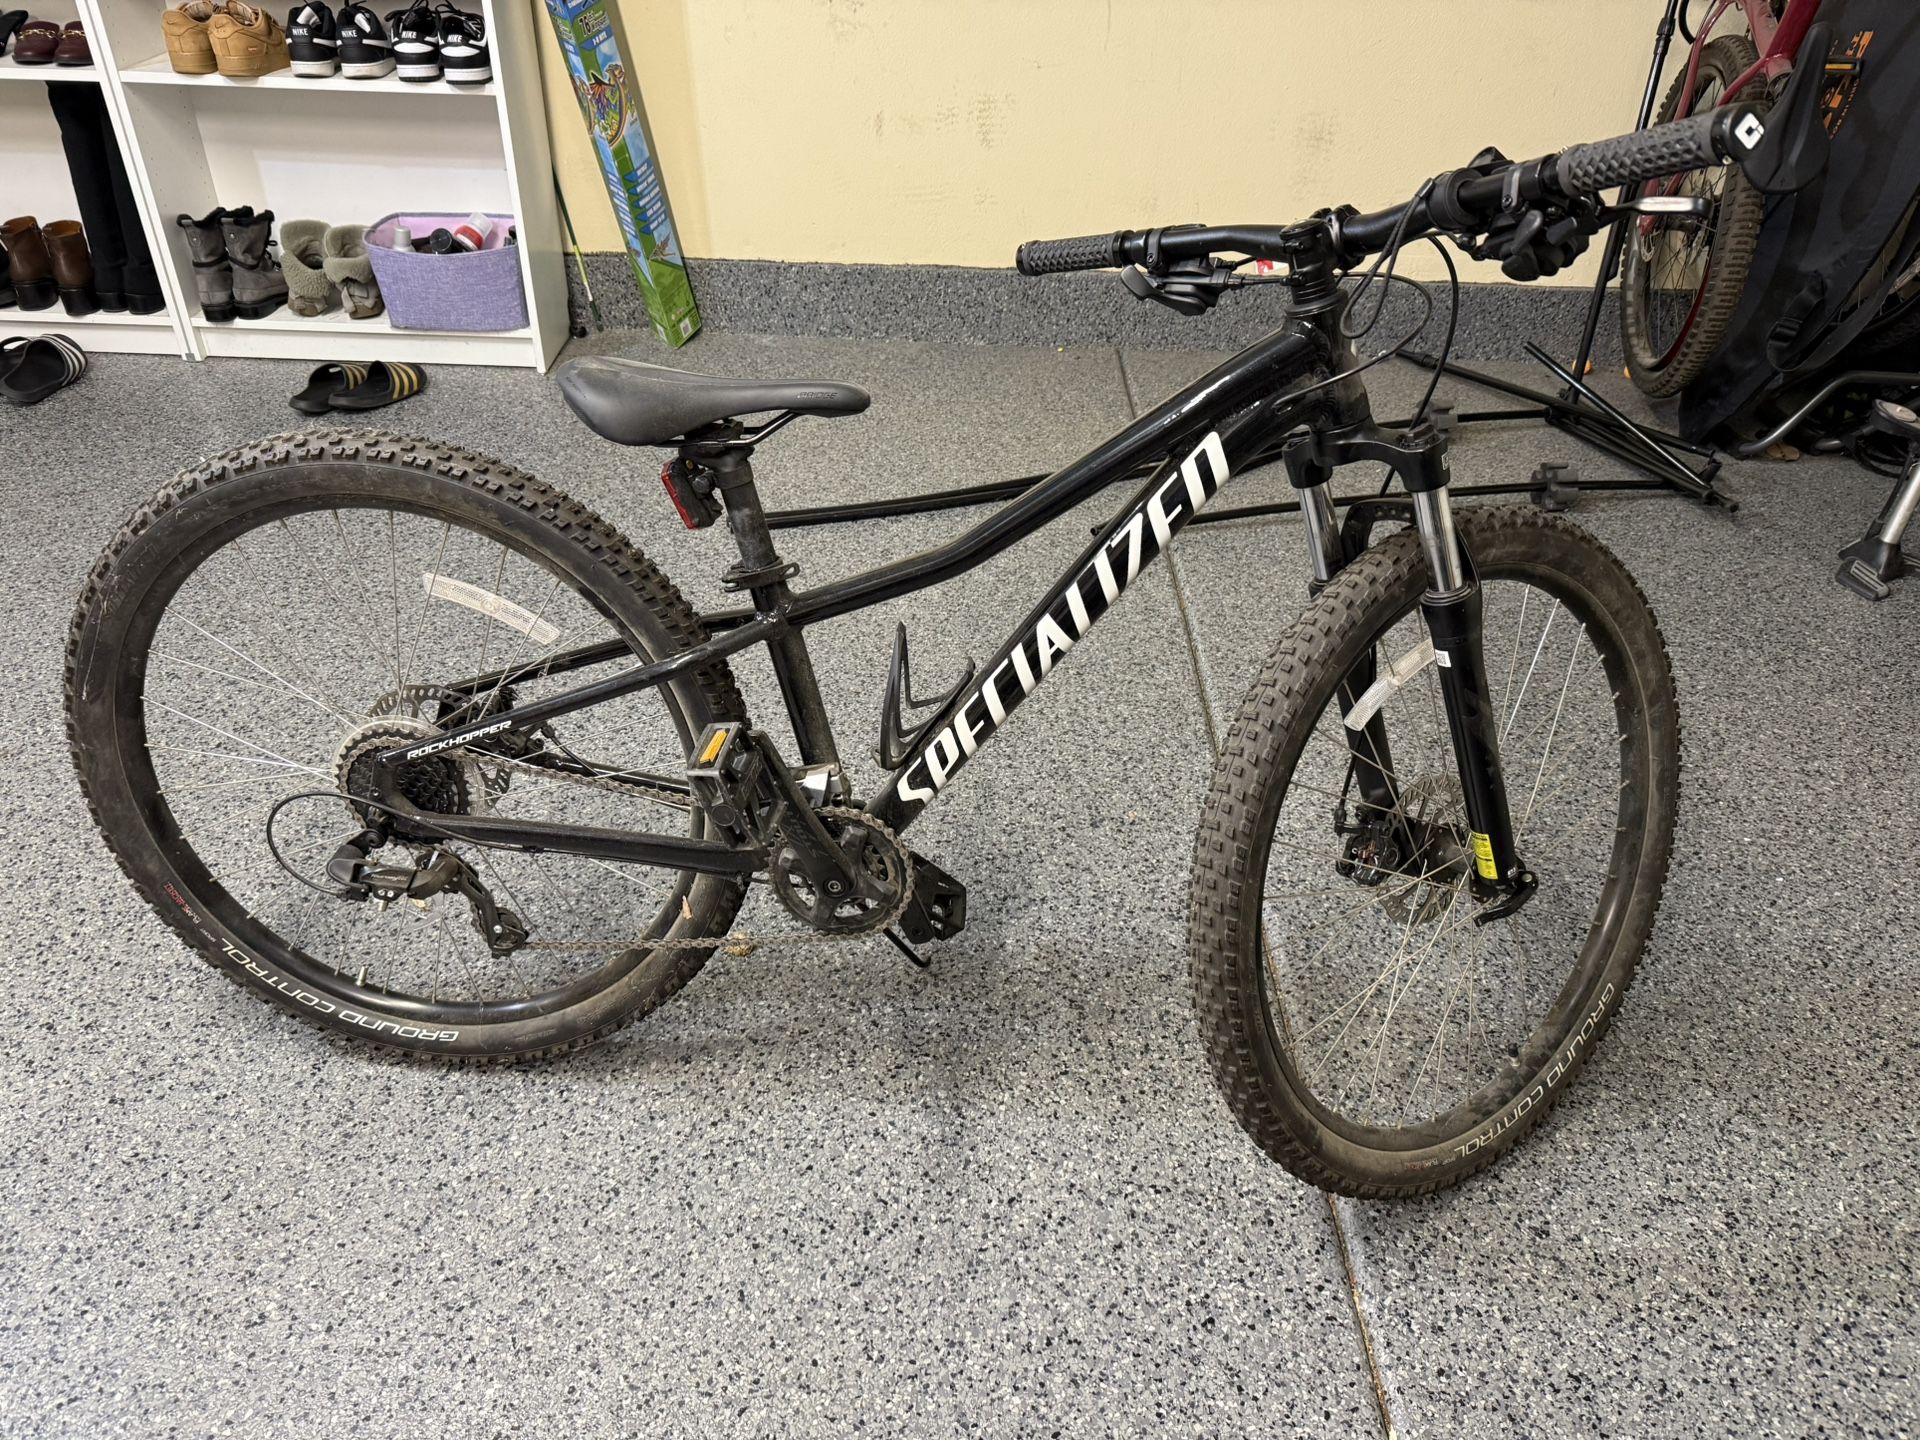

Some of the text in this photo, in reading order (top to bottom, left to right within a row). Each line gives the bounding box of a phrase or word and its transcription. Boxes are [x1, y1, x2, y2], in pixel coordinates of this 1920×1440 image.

[292, 28, 308, 36] NIKE
[341, 29, 357, 38] NIKE
[401, 30, 417, 39] NIKE
[447, 34, 463, 43] NIKE
[799, 391, 839, 400] BRIDGE
[407, 720, 512, 760] ROCKHOPPER
[221, 937, 460, 1042] GROUND CONTROL
[1454, 983, 1615, 1158] GROUND CONTROL
